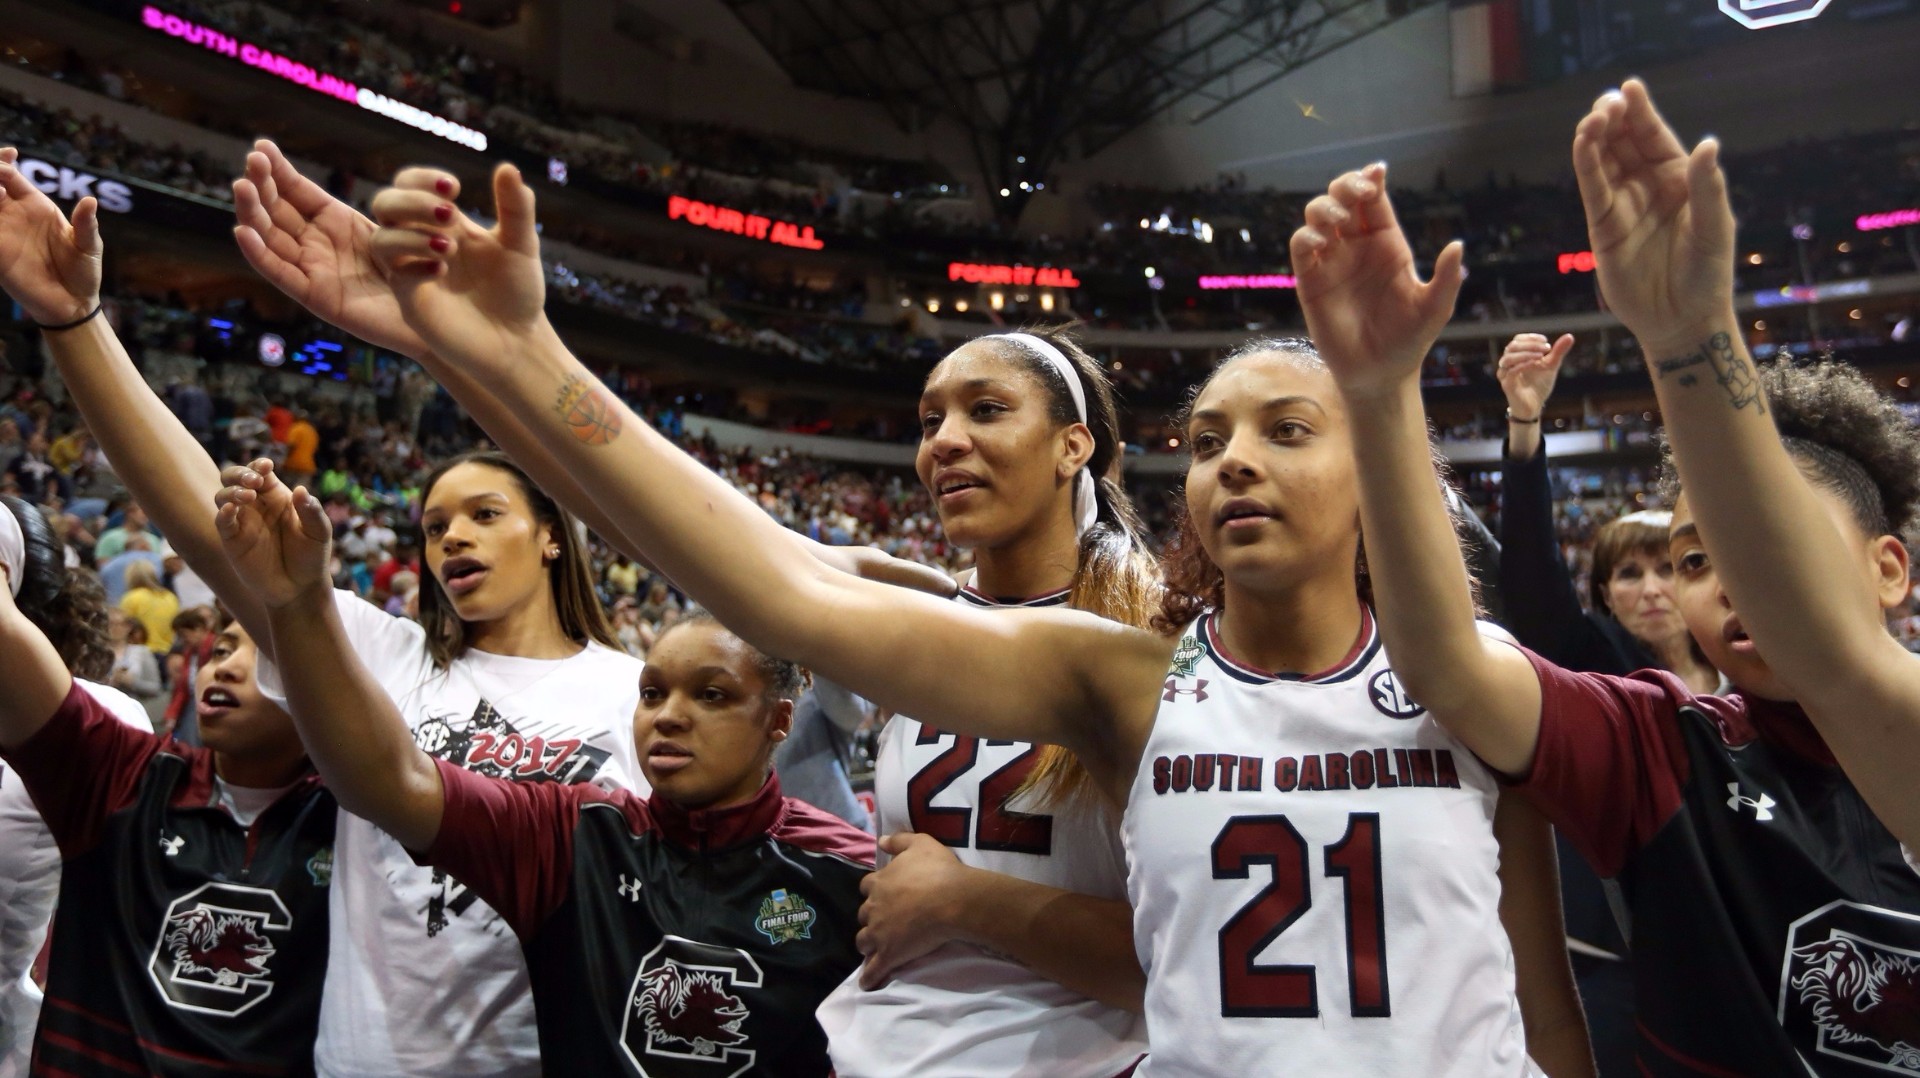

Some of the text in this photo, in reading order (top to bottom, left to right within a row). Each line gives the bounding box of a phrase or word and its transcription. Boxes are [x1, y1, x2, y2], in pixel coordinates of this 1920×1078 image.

[142, 6, 238, 57] SOUTH
[240, 44, 358, 104] CAROLINA
[668, 195, 824, 250] FOUR IT ALL
[949, 263, 1080, 288] FOUR IT ALL
[416, 721, 450, 752] SEC
[467, 732, 582, 776] 2017
[907, 724, 1053, 856] 22
[1153, 748, 1461, 795] SOUTH CAROLINA
[762, 911, 810, 929] FINAL FOUR
[1211, 812, 1391, 1018] 21
